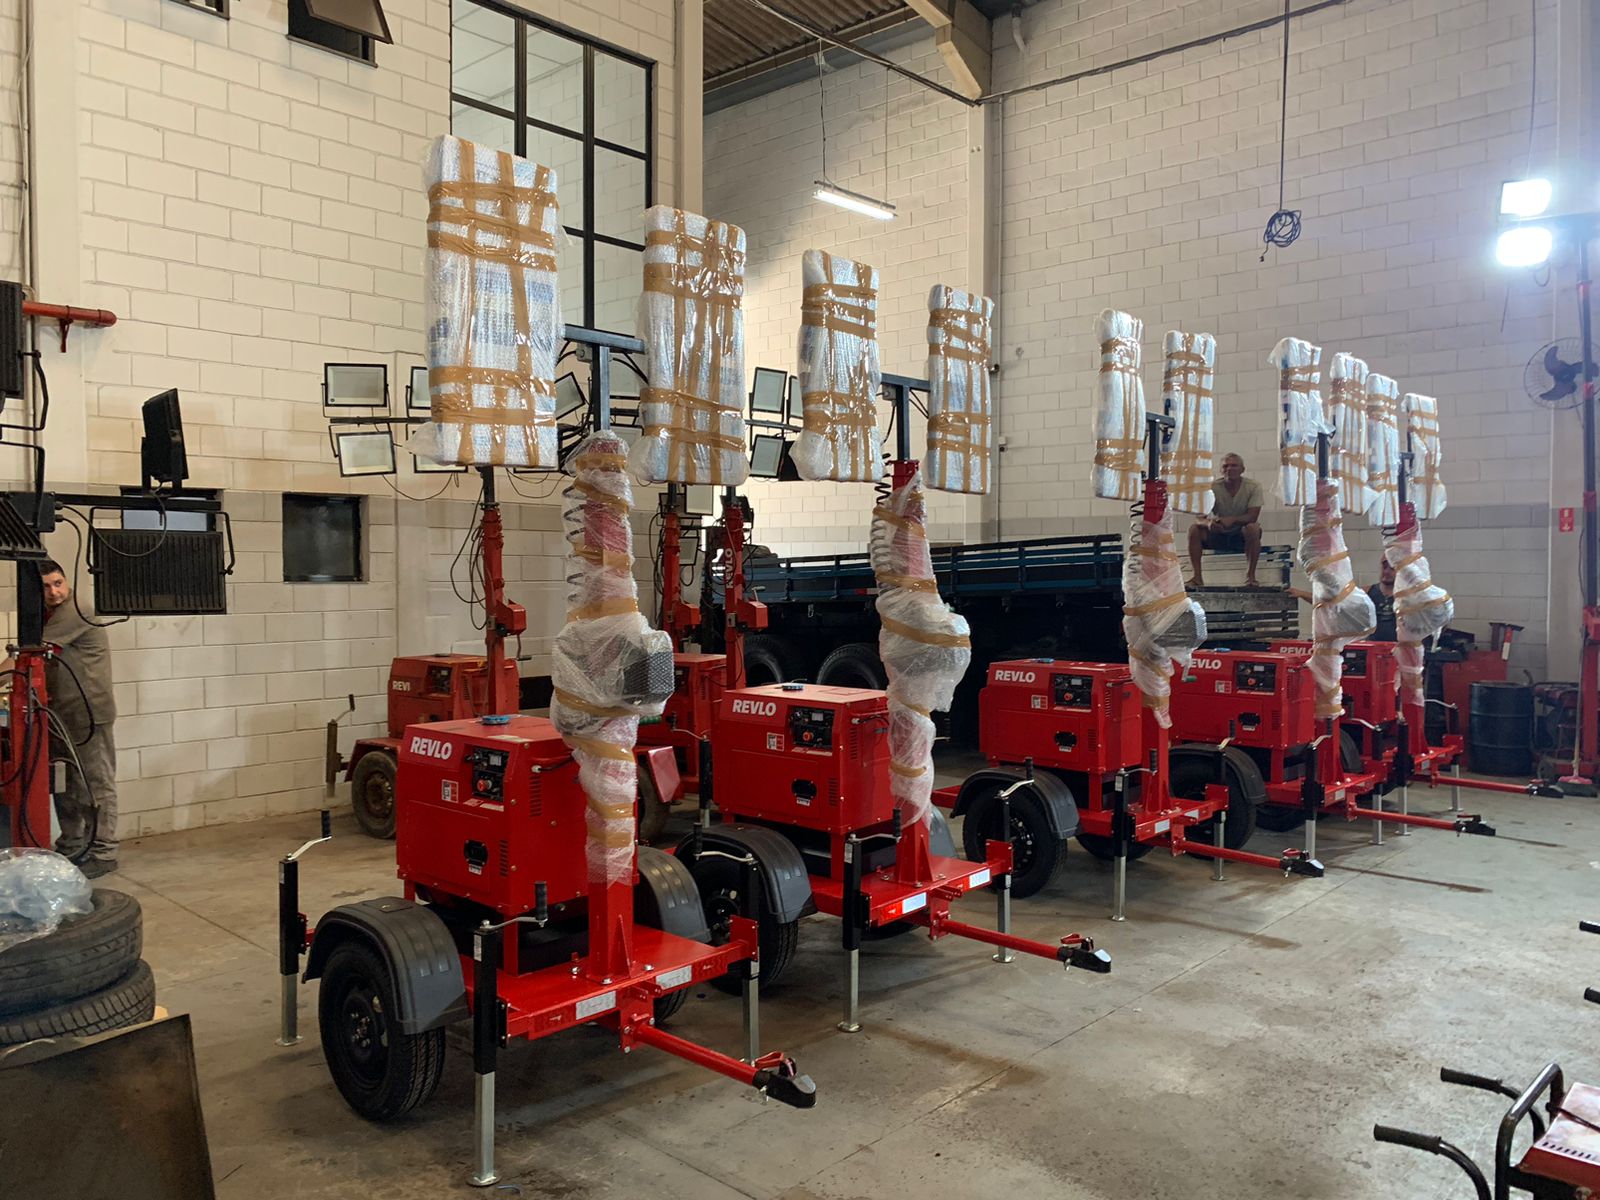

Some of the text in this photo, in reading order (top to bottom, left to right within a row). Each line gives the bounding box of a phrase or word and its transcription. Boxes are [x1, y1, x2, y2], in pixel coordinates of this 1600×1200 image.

[725, 548, 733, 588] REVLO
[1181, 658, 1221, 670] EVLO
[994, 670, 1036, 683] REVLO
[732, 699, 777, 716] REVLO
[410, 736, 452, 760] REVLO
